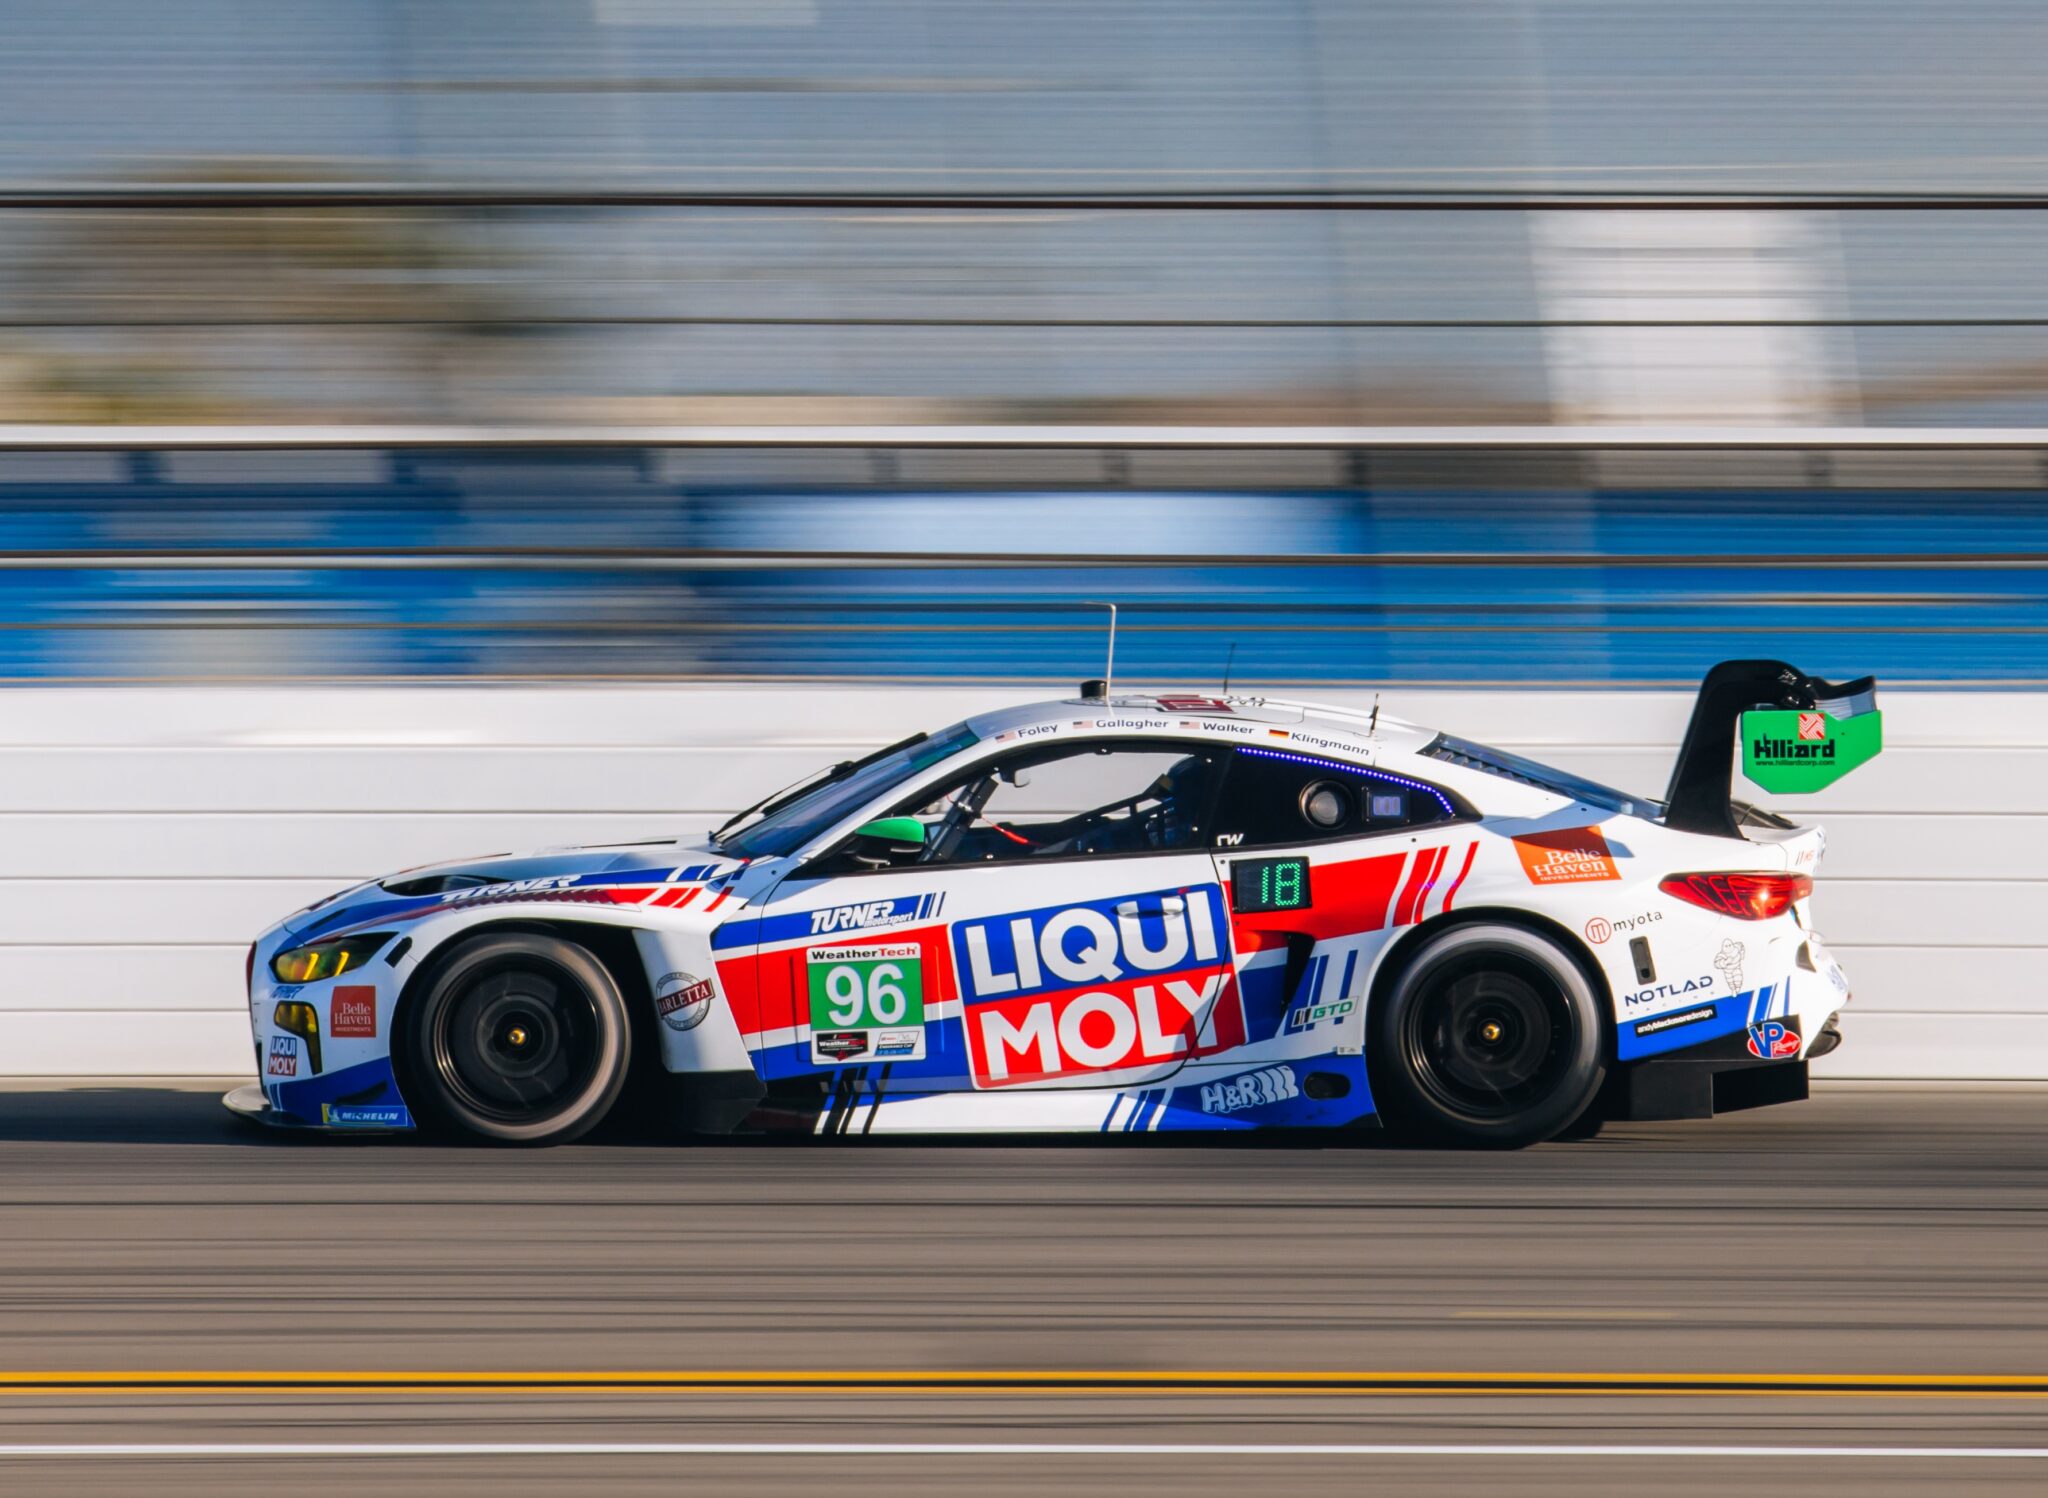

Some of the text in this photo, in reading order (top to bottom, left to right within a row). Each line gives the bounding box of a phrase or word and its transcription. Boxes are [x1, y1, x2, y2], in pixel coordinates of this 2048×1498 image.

[1018, 725, 1058, 738] Foley
[1096, 719, 1169, 730] Gallagher
[1203, 722, 1254, 734] Walker
[1291, 732, 1369, 756] Klingmann
[1754, 735, 1835, 758] Hilliard
[1546, 849, 1602, 866] Belle
[1532, 860, 1608, 877] Haven
[1540, 872, 1610, 881] INVESTMENTS
[1261, 863, 1301, 906] 18
[811, 901, 895, 934] TURNER
[1613, 911, 1663, 932] myota
[812, 946, 917, 960] WeatherTech
[965, 891, 1219, 996] LIQUI
[826, 964, 906, 1027] 96
[1625, 976, 1713, 1007] NOTLAD
[343, 1003, 371, 1015] Belle
[1313, 1001, 1354, 1019] GTD
[334, 1013, 371, 1025] Haven
[979, 973, 1232, 1080] MOLY
[271, 1037, 296, 1056] LIQUI
[1750, 1022, 1785, 1058] VP
[268, 1056, 296, 1076] MOLY
[342, 1112, 399, 1120] MICHELIN
